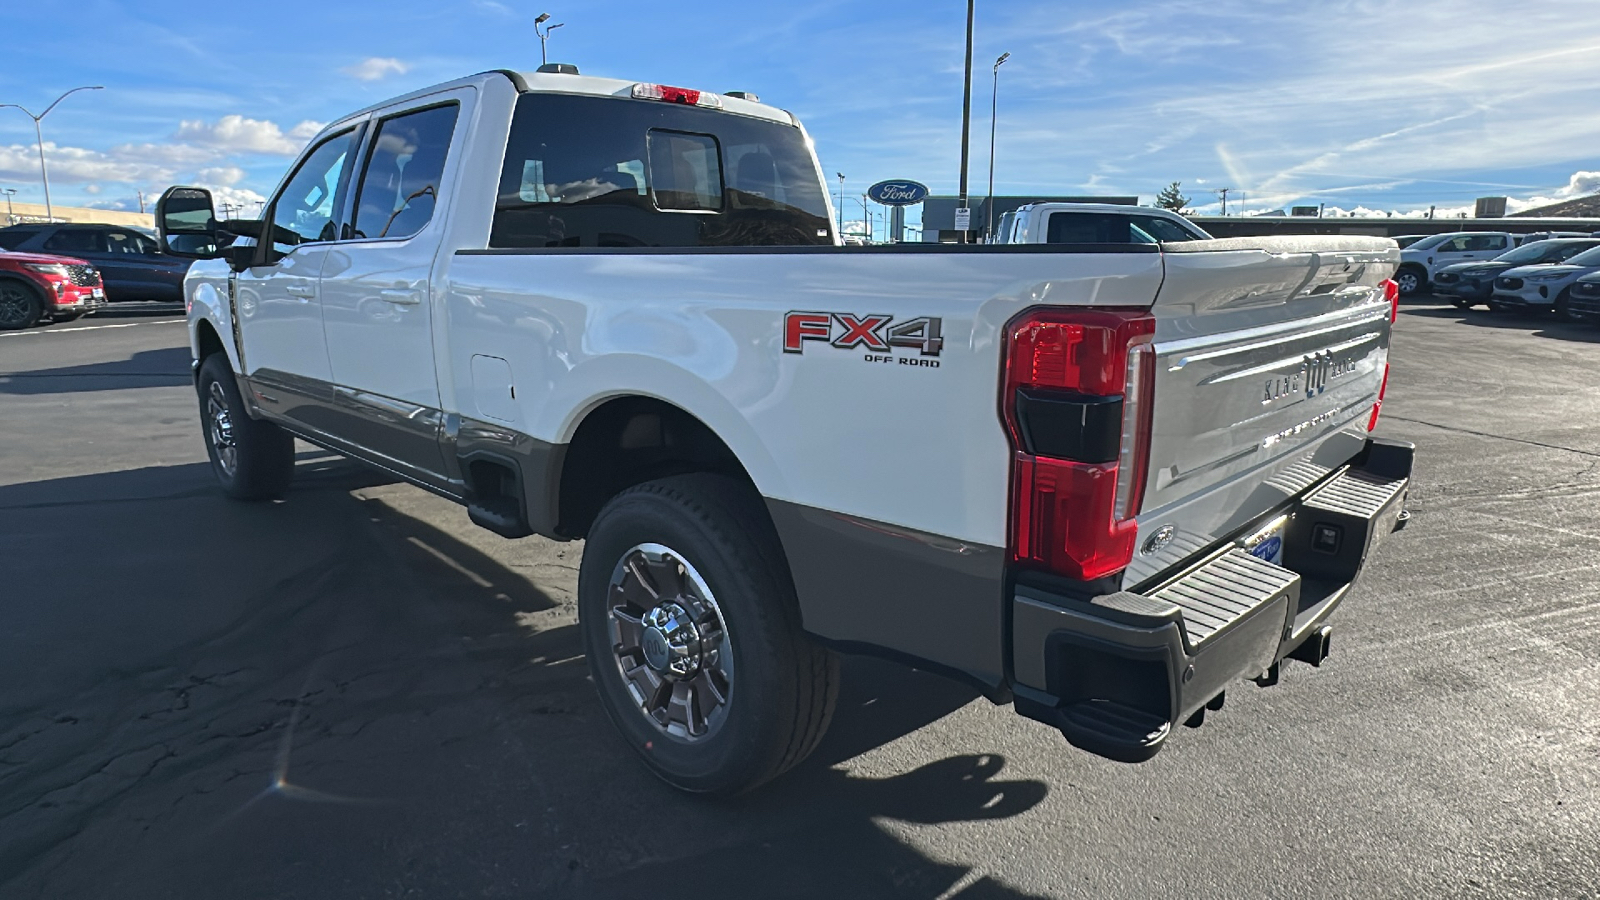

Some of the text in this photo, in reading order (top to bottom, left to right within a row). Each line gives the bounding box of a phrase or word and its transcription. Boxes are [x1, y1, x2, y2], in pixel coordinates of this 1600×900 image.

[880, 184, 916, 200] Ford
[783, 310, 944, 356] FX4
[864, 354, 940, 368] OFF ROAD
